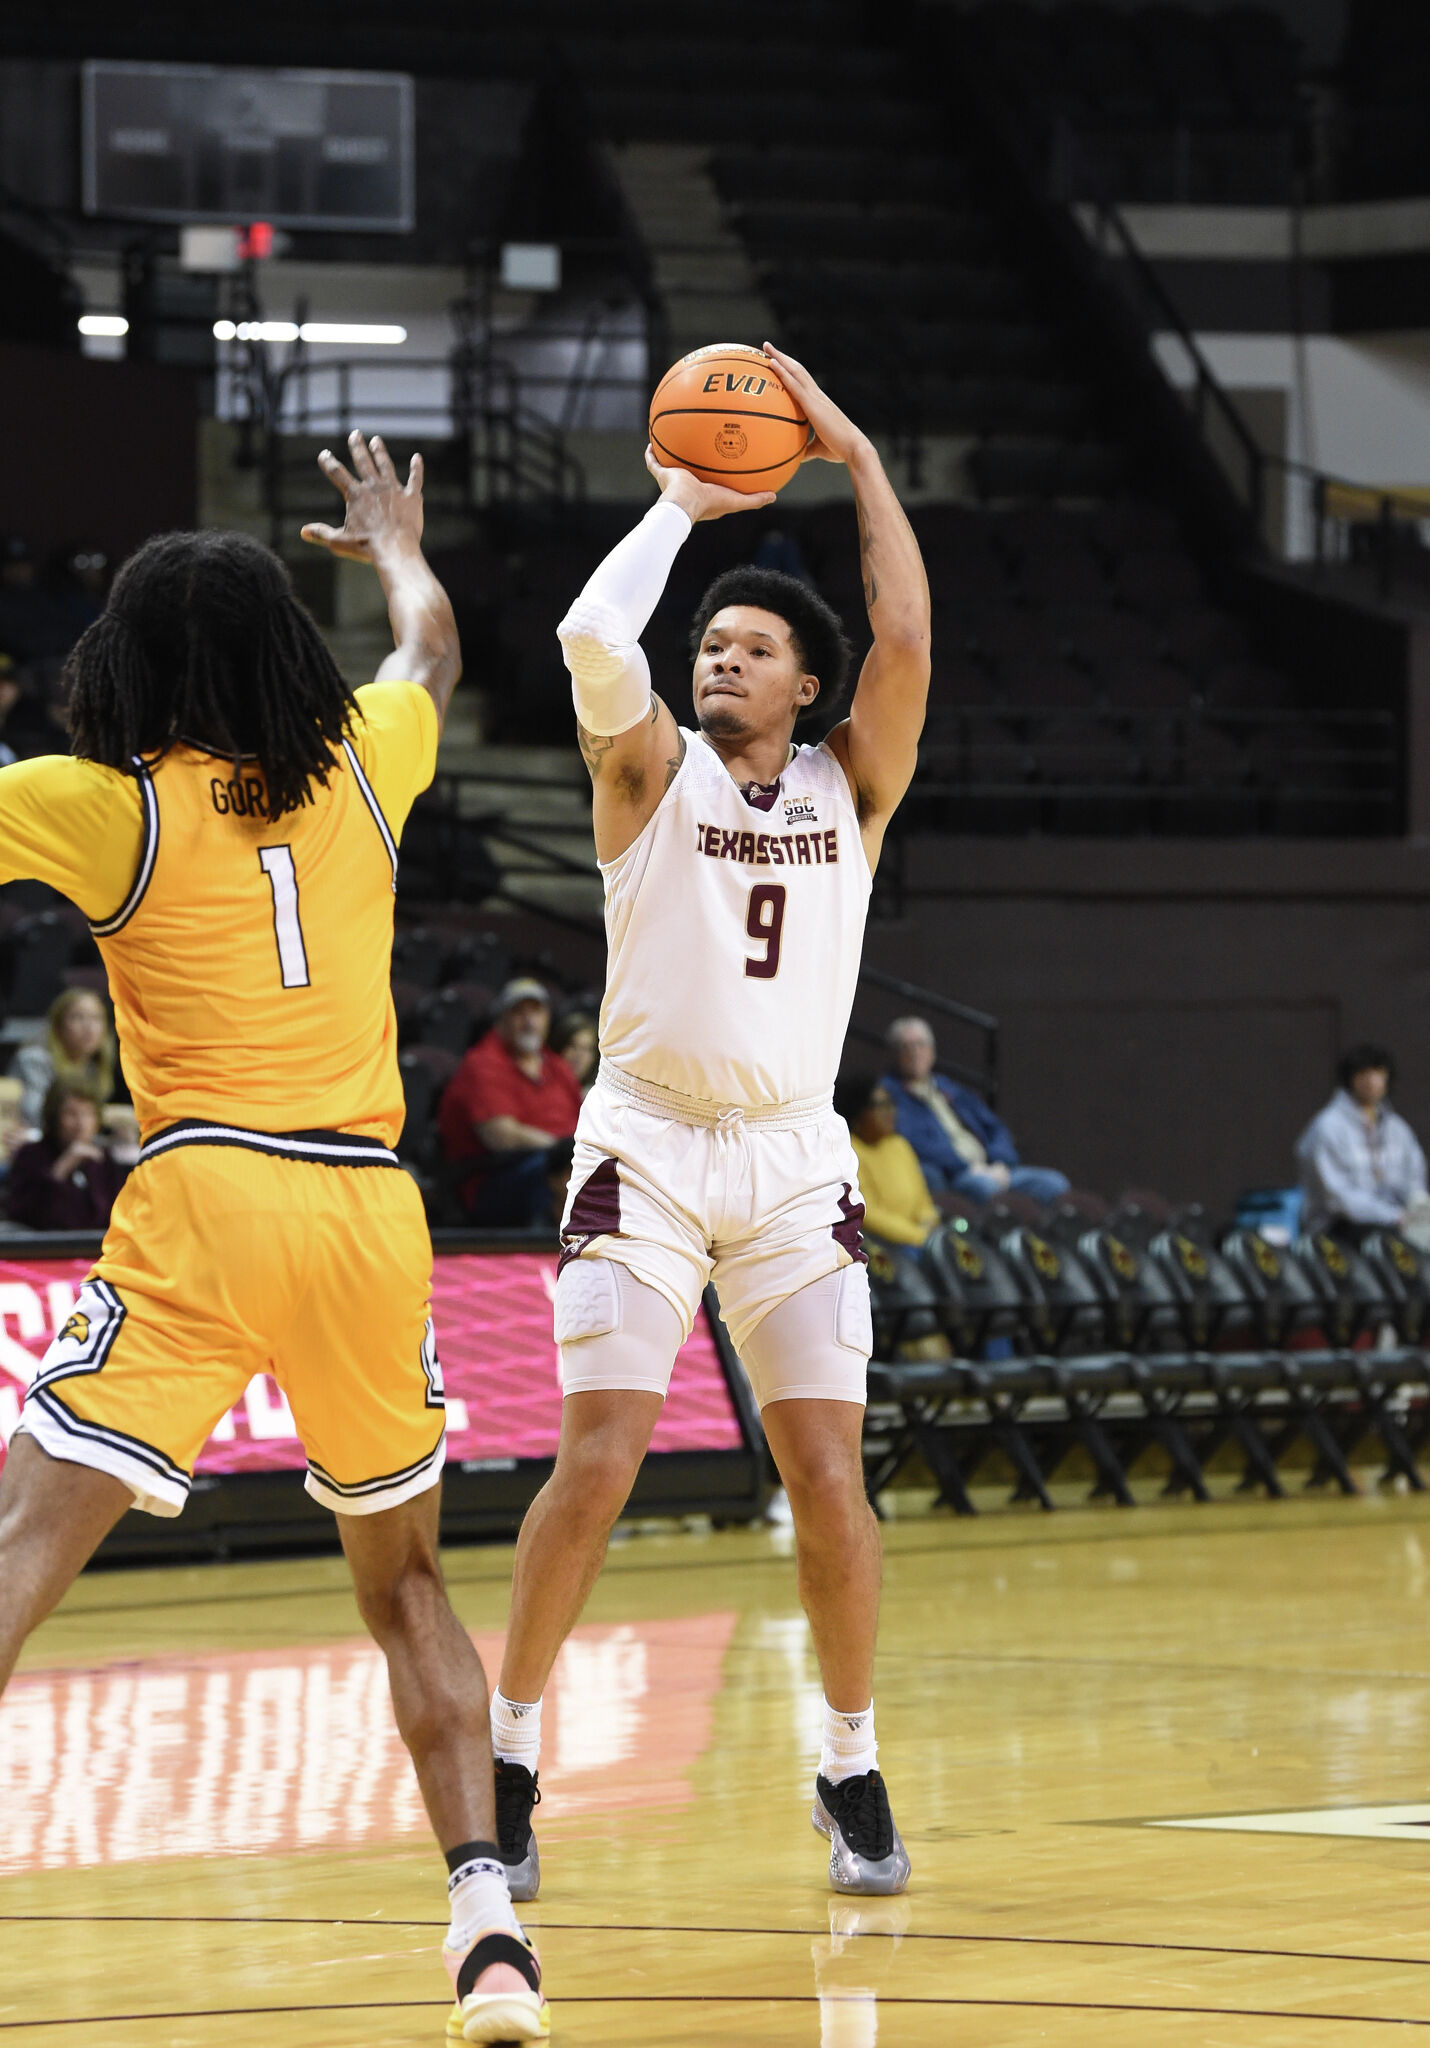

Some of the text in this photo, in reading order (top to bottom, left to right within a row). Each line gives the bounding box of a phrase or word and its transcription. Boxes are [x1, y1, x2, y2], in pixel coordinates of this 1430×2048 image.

[702, 373, 768, 395] EVO
[210, 778, 315, 817] GORN
[783, 796, 815, 816] SBC
[257, 844, 311, 989] 1
[743, 881, 788, 981] 9
